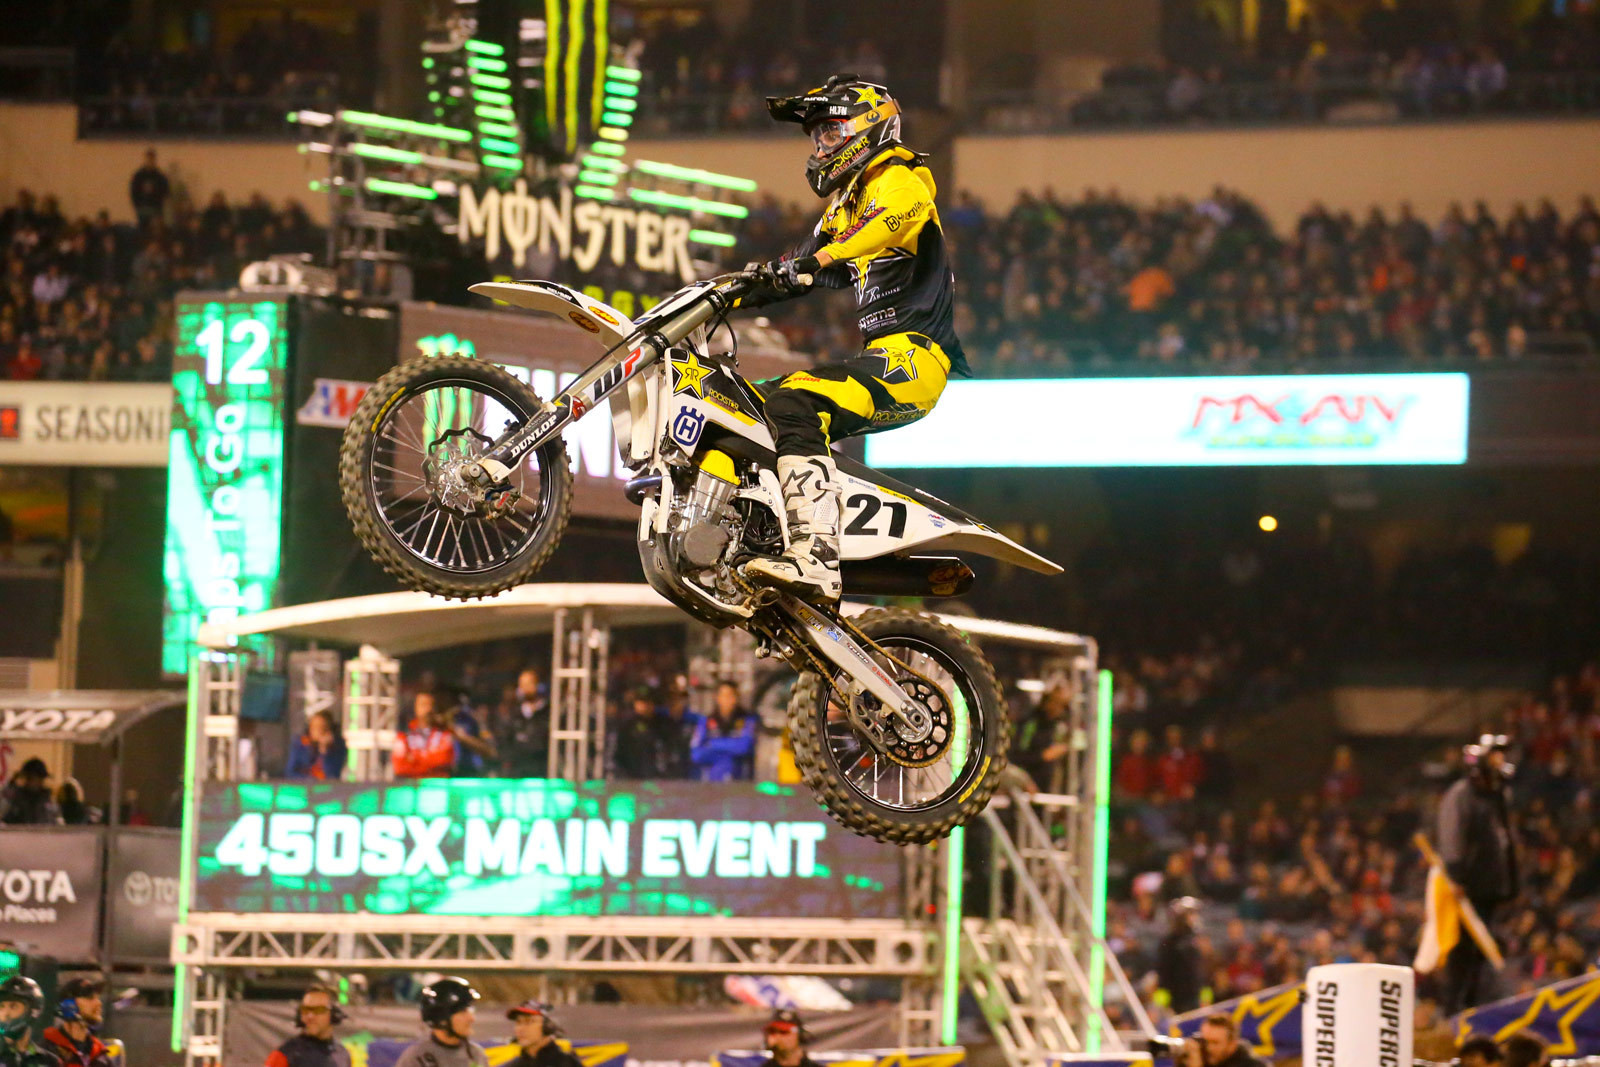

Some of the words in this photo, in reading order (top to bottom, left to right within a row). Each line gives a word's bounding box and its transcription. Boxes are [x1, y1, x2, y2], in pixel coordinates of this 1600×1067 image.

[458, 178, 697, 282] MONSTER
[196, 319, 271, 385] 12
[206, 404, 246, 473] Go
[510, 414, 557, 458] DUNLOP
[844, 493, 906, 538] 21
[215, 813, 450, 877] 450SX
[463, 817, 631, 877] MAIN
[641, 819, 826, 878] EVENT
